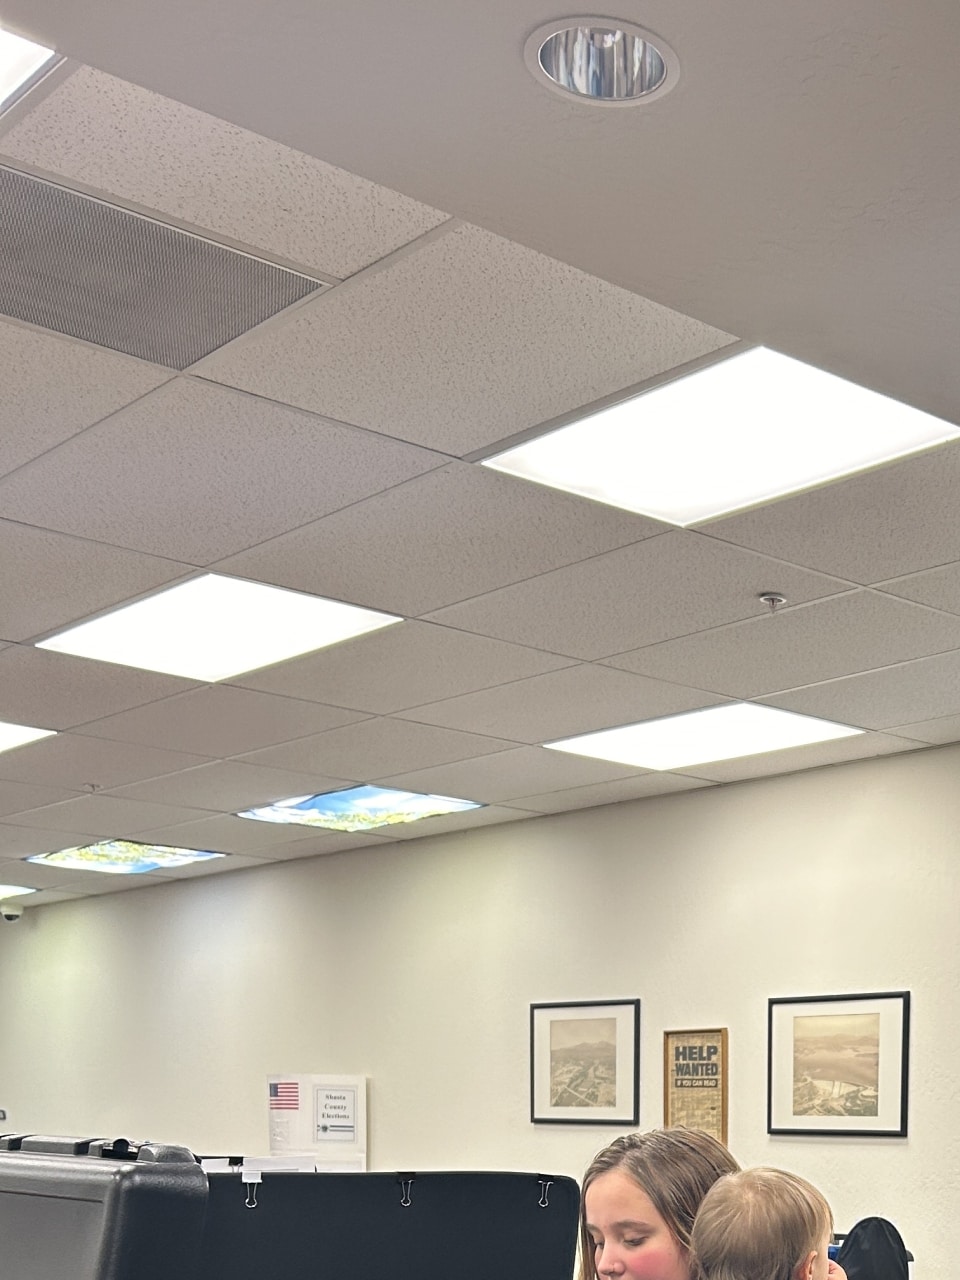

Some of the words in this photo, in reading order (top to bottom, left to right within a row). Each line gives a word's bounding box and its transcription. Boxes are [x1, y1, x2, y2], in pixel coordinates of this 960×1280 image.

[675, 1045, 718, 1061] HELP
[675, 1063, 718, 1076] WANTED
[682, 1079, 692, 1087] YOU
[692, 1079, 703, 1087] CAN
[324, 1103, 347, 1111] County
